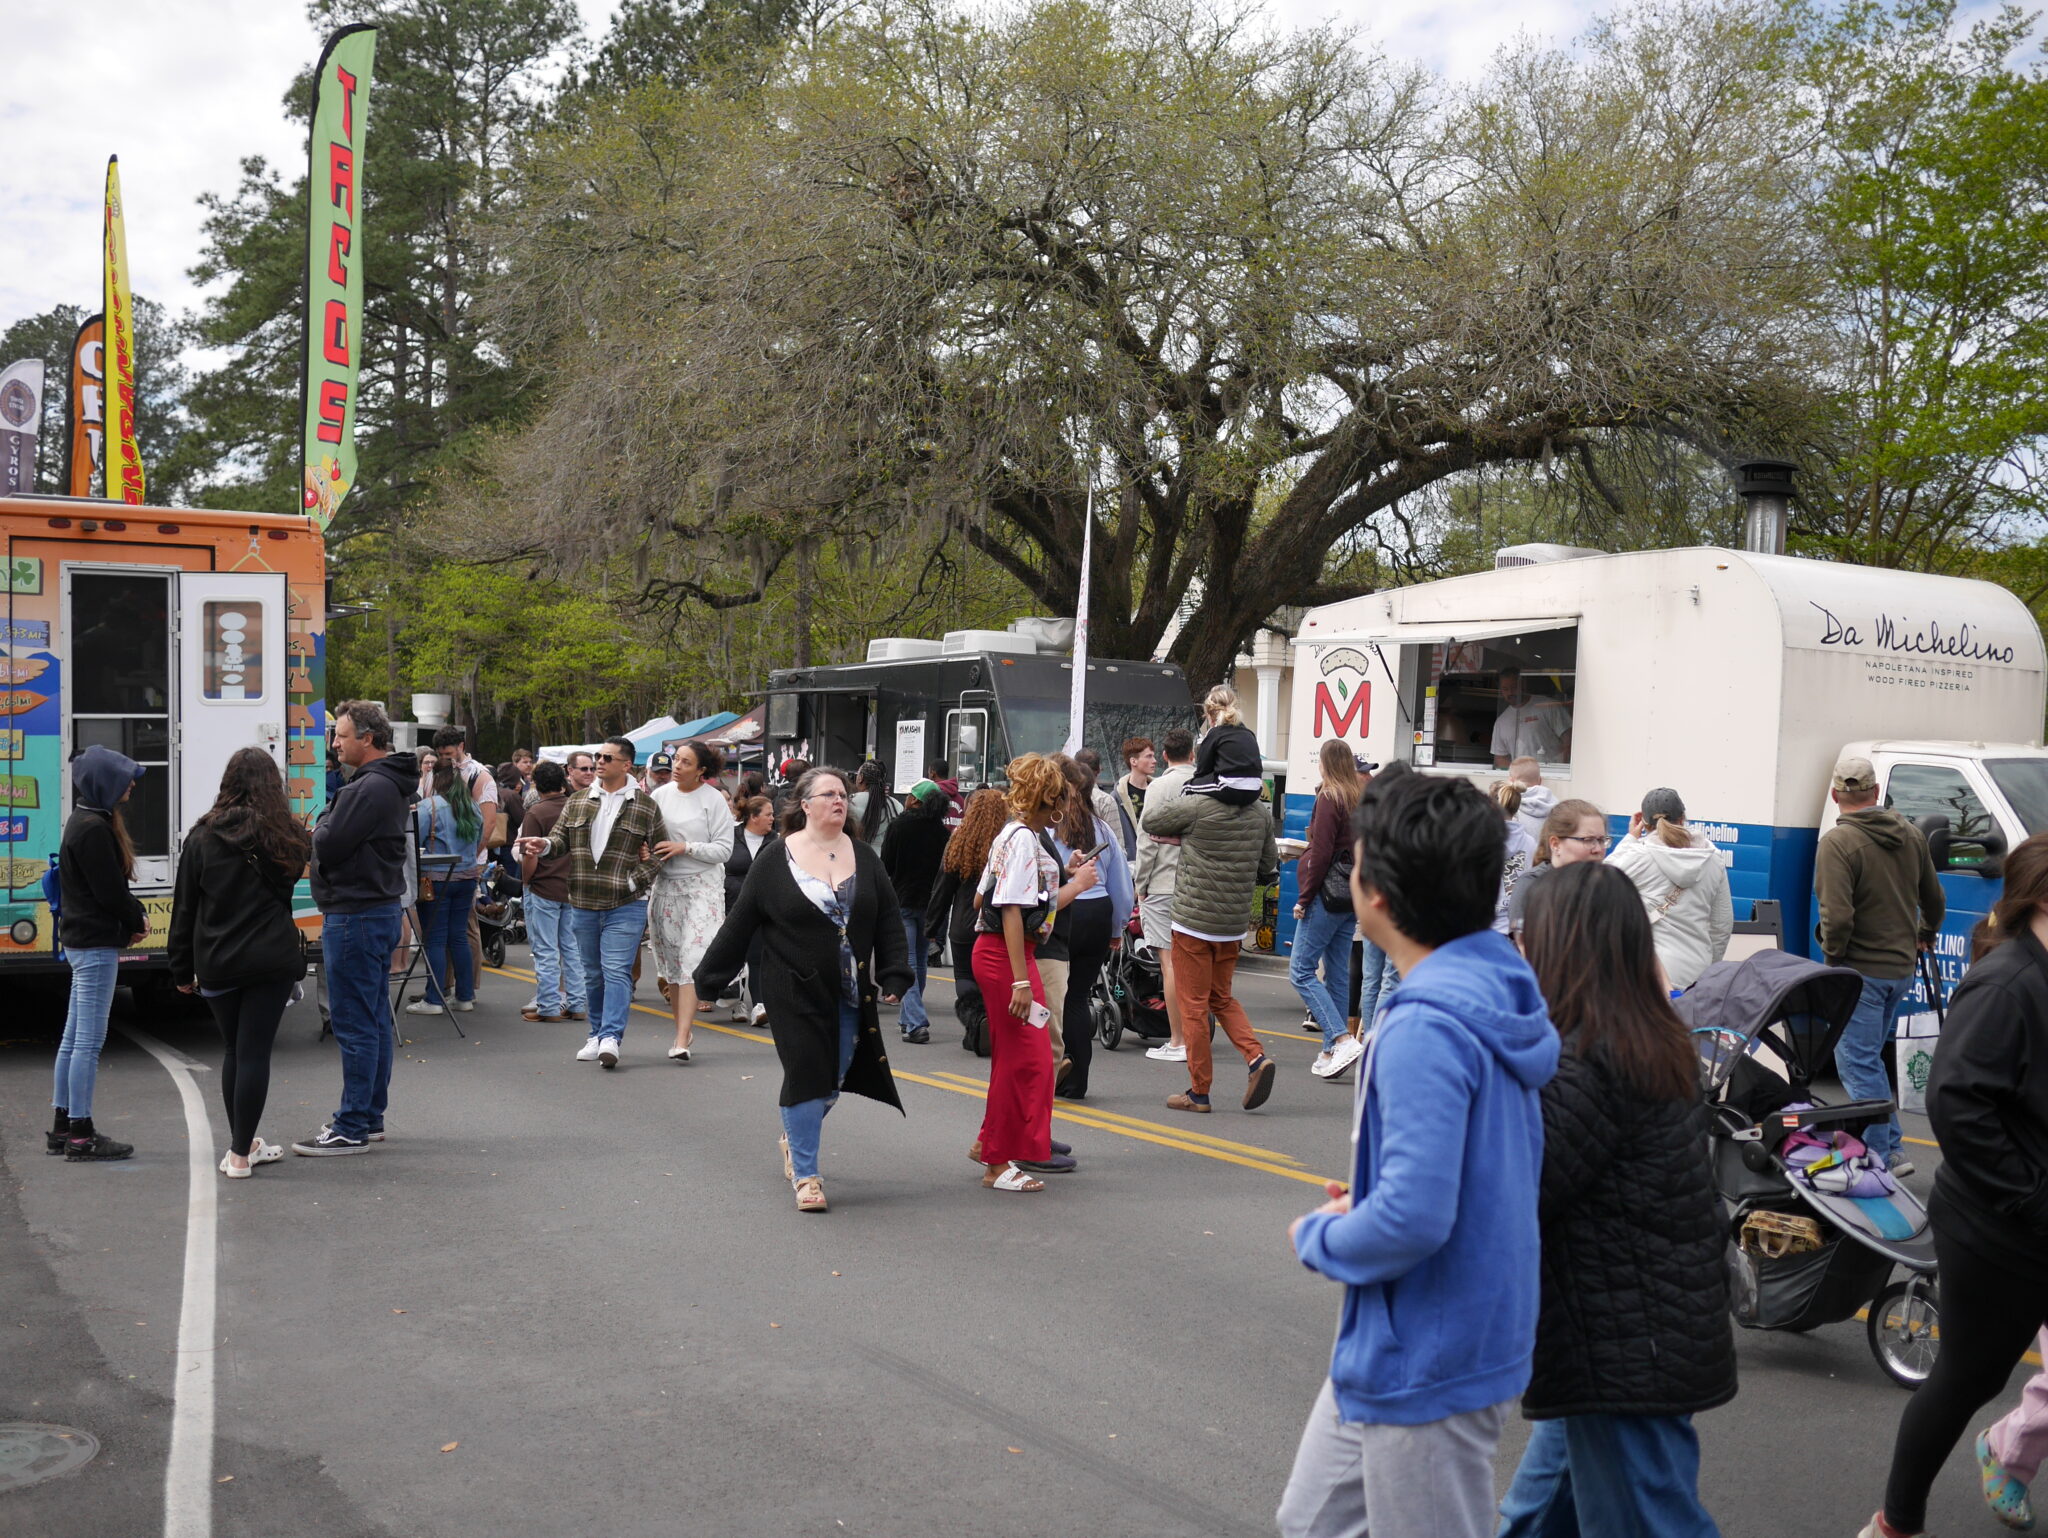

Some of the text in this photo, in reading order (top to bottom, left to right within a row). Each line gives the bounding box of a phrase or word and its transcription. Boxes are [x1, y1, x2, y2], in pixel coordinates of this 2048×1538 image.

[318, 64, 357, 445] TACOS
[8, 435, 20, 487] GYROS
[1809, 600, 2014, 664] Da Michelino
[1865, 660, 1973, 680] NAPOLETANA INSPIRED
[1867, 675, 1971, 692] WOOD FIRED PIZZERIA
[1313, 680, 1371, 739] M
